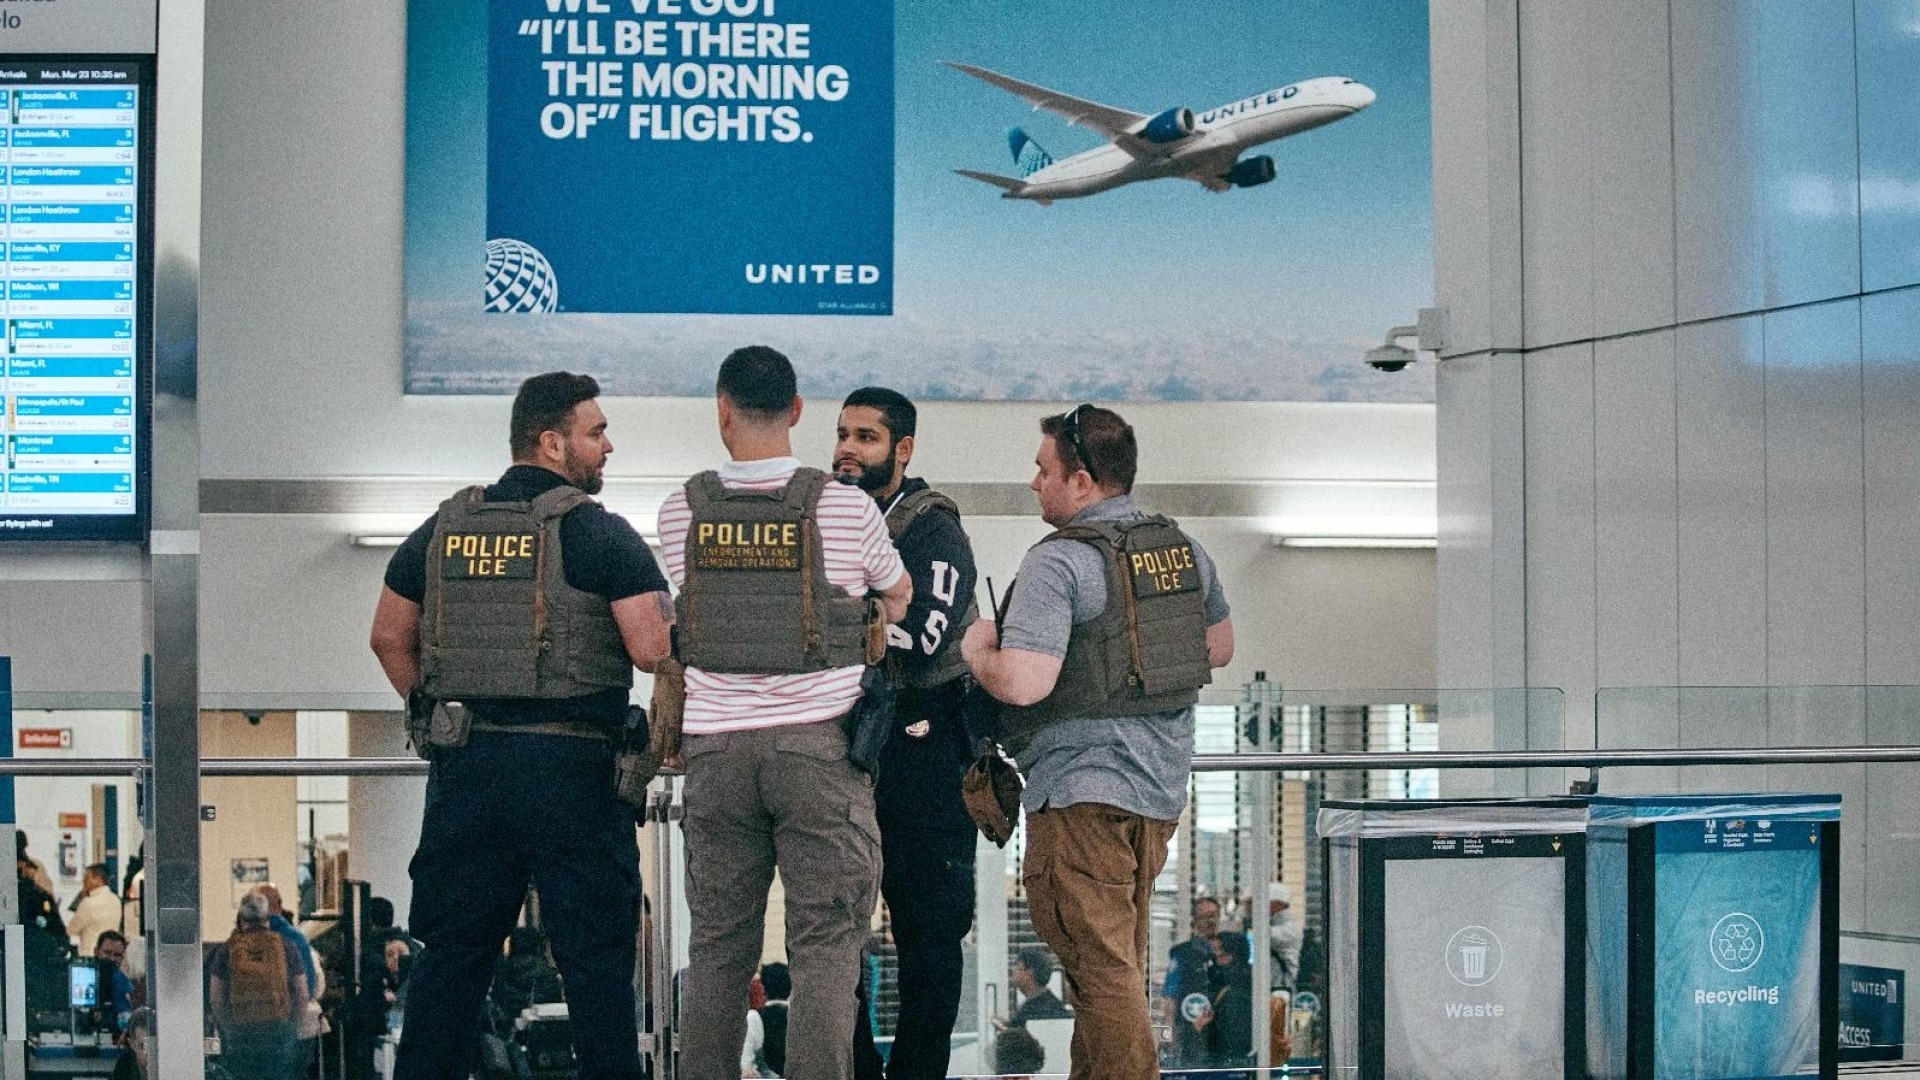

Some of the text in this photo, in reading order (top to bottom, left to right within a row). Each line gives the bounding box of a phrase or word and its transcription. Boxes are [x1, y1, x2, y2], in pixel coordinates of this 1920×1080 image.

[0, 10, 21, 29] lo
[615, 20, 667, 55] BE
[675, 21, 810, 58] THERE
[78, 70, 90, 79] 23
[541, 61, 850, 101] THE MORNING
[127, 92, 133, 100] 2
[1202, 86, 1298, 123] UNITED
[540, 102, 813, 142] OF" FLIGHTS.
[13, 168, 81, 176] London Heathrow
[12, 206, 80, 214] London Heathrow
[49, 245, 60, 253] KY
[745, 263, 880, 284] UNITED
[18, 321, 45, 330] Miami,
[11, 359, 38, 368] Miami,
[18, 437, 53, 445] Montreal
[698, 523, 797, 545] POLICE
[446, 535, 534, 557] POLICE
[703, 547, 789, 556] ENFORCEMENT AND
[469, 559, 507, 575] ICE
[742, 558, 797, 568] OPERATIONS
[1132, 547, 1193, 577] POLICE
[1155, 572, 1182, 591] ICE
[1694, 986, 1779, 1006] Recycling
[1851, 980, 1887, 997] UNITED
[1445, 1003, 1505, 1018] Waste
[1838, 1020, 1871, 1046] Access
